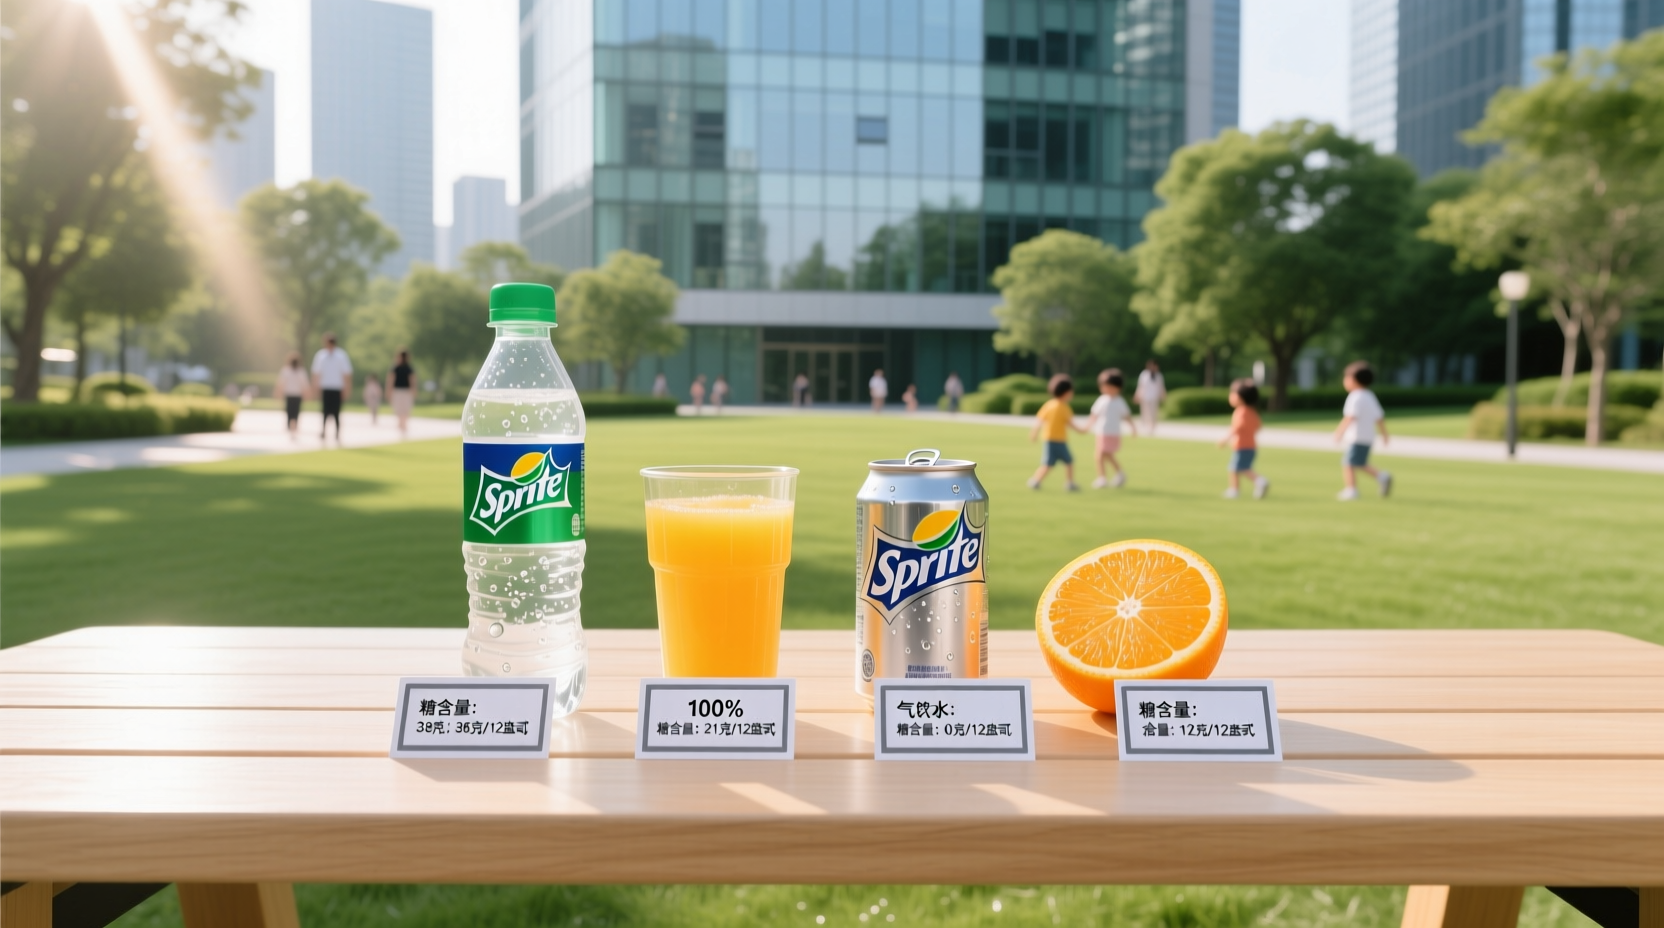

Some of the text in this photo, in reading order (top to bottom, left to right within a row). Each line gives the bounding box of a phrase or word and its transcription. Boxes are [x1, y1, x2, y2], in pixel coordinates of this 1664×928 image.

[479, 463, 563, 524] Sprite
[870, 522, 979, 605] Sprite
[688, 699, 744, 717] 100%
